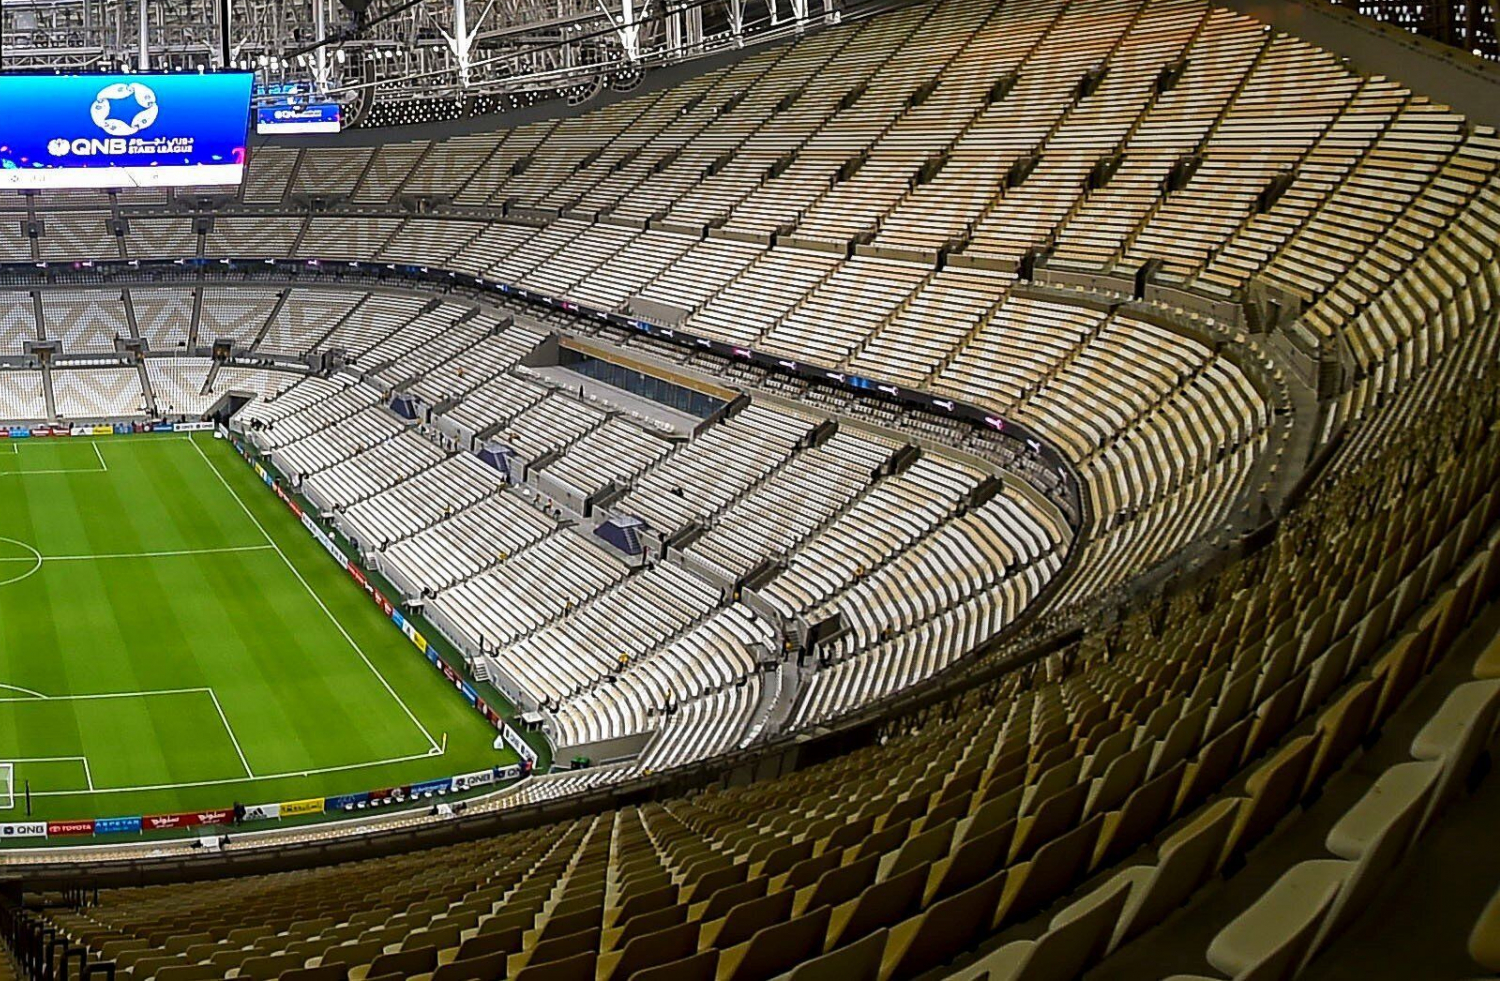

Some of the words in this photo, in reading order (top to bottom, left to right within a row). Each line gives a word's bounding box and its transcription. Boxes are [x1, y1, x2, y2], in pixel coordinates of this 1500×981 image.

[71, 138, 127, 156] QNB
[157, 146, 193, 154] LEAGUE
[467, 773, 491, 783] QNB
[17, 825, 44, 835] QNB
[62, 824, 92, 832] TOYOTA
